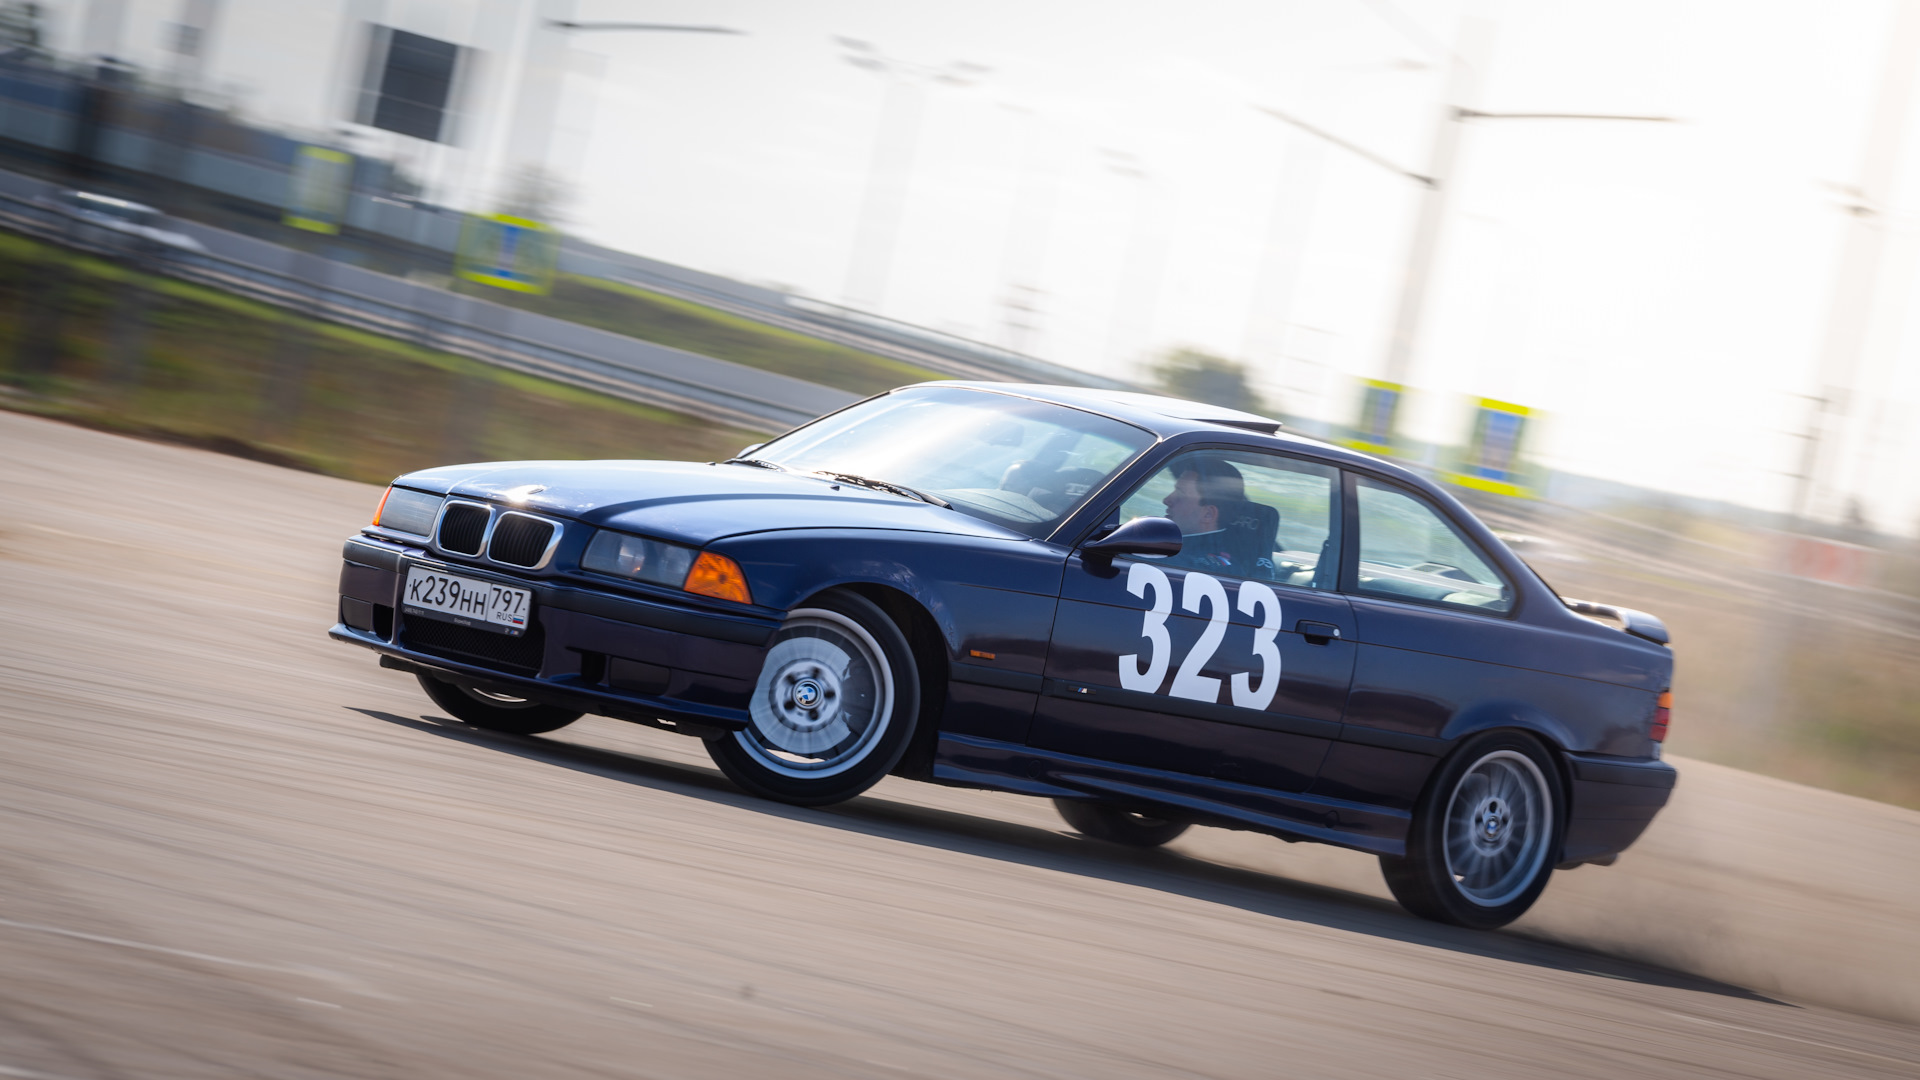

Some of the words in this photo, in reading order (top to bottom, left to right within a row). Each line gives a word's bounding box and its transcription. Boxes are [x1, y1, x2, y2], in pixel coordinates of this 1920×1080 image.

[491, 587, 524, 614] 797
[496, 611, 513, 622] RUS
[1118, 562, 1283, 711] 323
